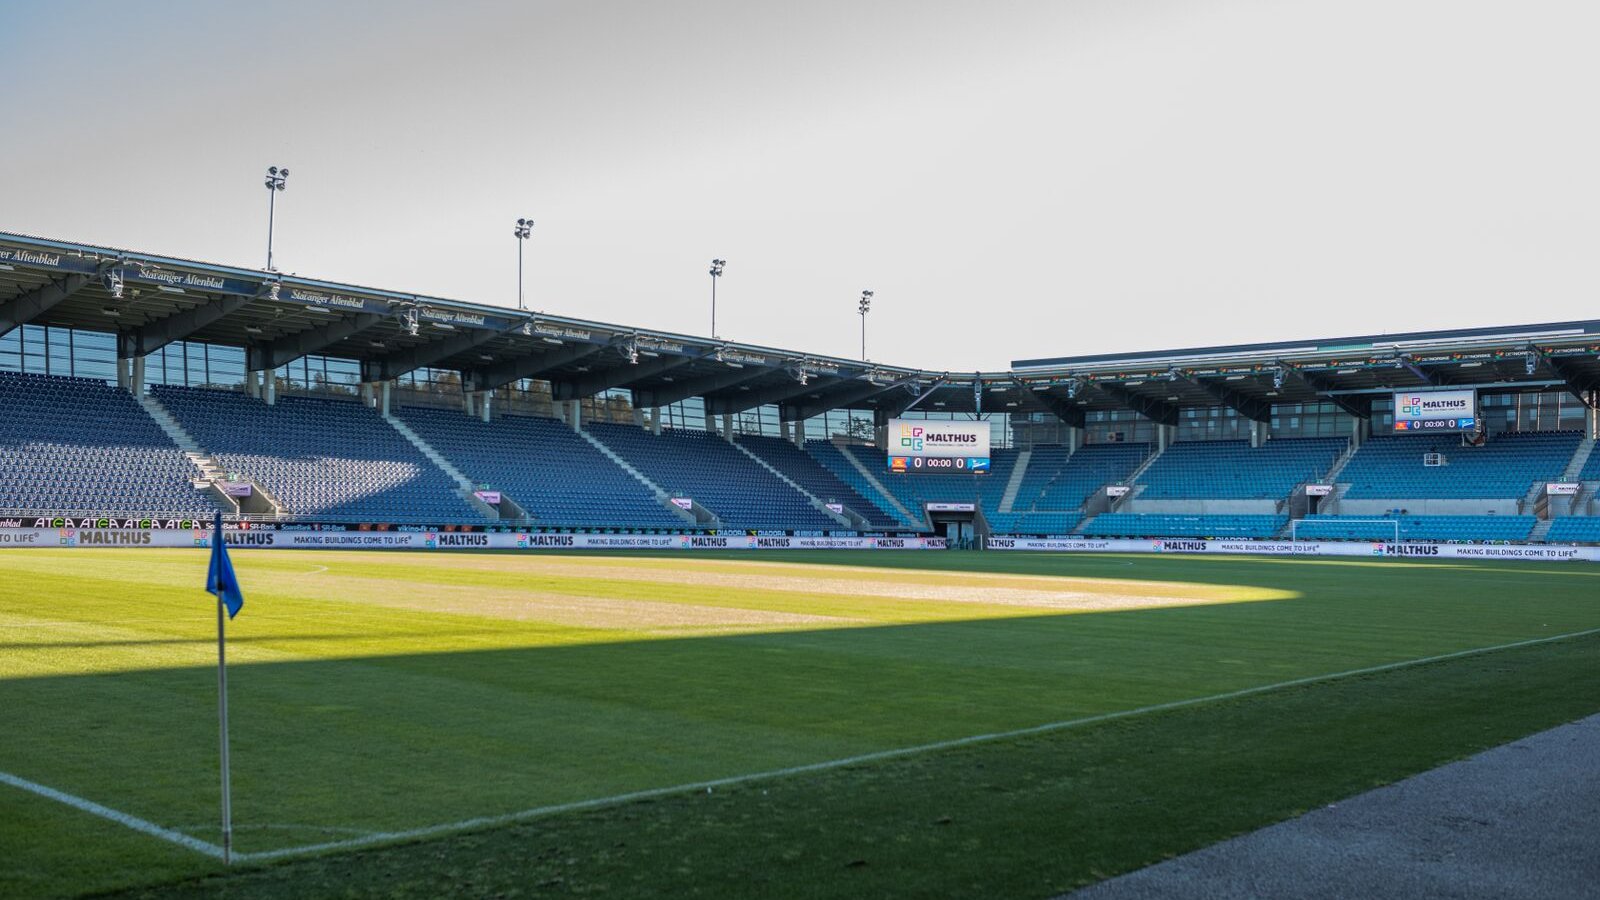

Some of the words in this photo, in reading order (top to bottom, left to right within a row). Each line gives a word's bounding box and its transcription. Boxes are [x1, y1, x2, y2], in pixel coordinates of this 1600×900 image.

[12, 249, 59, 266] Aftenblad
[139, 268, 183, 284] Stavanger
[183, 273, 224, 288] Aftenblad
[291, 289, 329, 304] Stavanger
[329, 295, 364, 308] Aftenblad
[1423, 400, 1466, 408] MALTHUS
[1413, 421, 1420, 429] 0
[1448, 420, 1455, 428] 0
[926, 434, 976, 442] MALTHUS
[914, 458, 922, 468] 0
[927, 459, 951, 467] 00:00
[956, 458, 964, 468] 0
[34, 518, 75, 528] ATEA
[80, 518, 119, 528] ATEA
[123, 519, 161, 529] ATEA
[165, 520, 201, 529] ATEA
[80, 532, 151, 544] MALTHUS
[224, 533, 274, 545] ALTHUS
[439, 535, 488, 545] MALTHUS
[529, 536, 573, 546] MALTHUS
[691, 538, 727, 546] MALTHUS
[757, 538, 790, 547] MALTHUS
[1164, 542, 1207, 550] MALTHUS
[1387, 545, 1438, 555] MALTHUS
